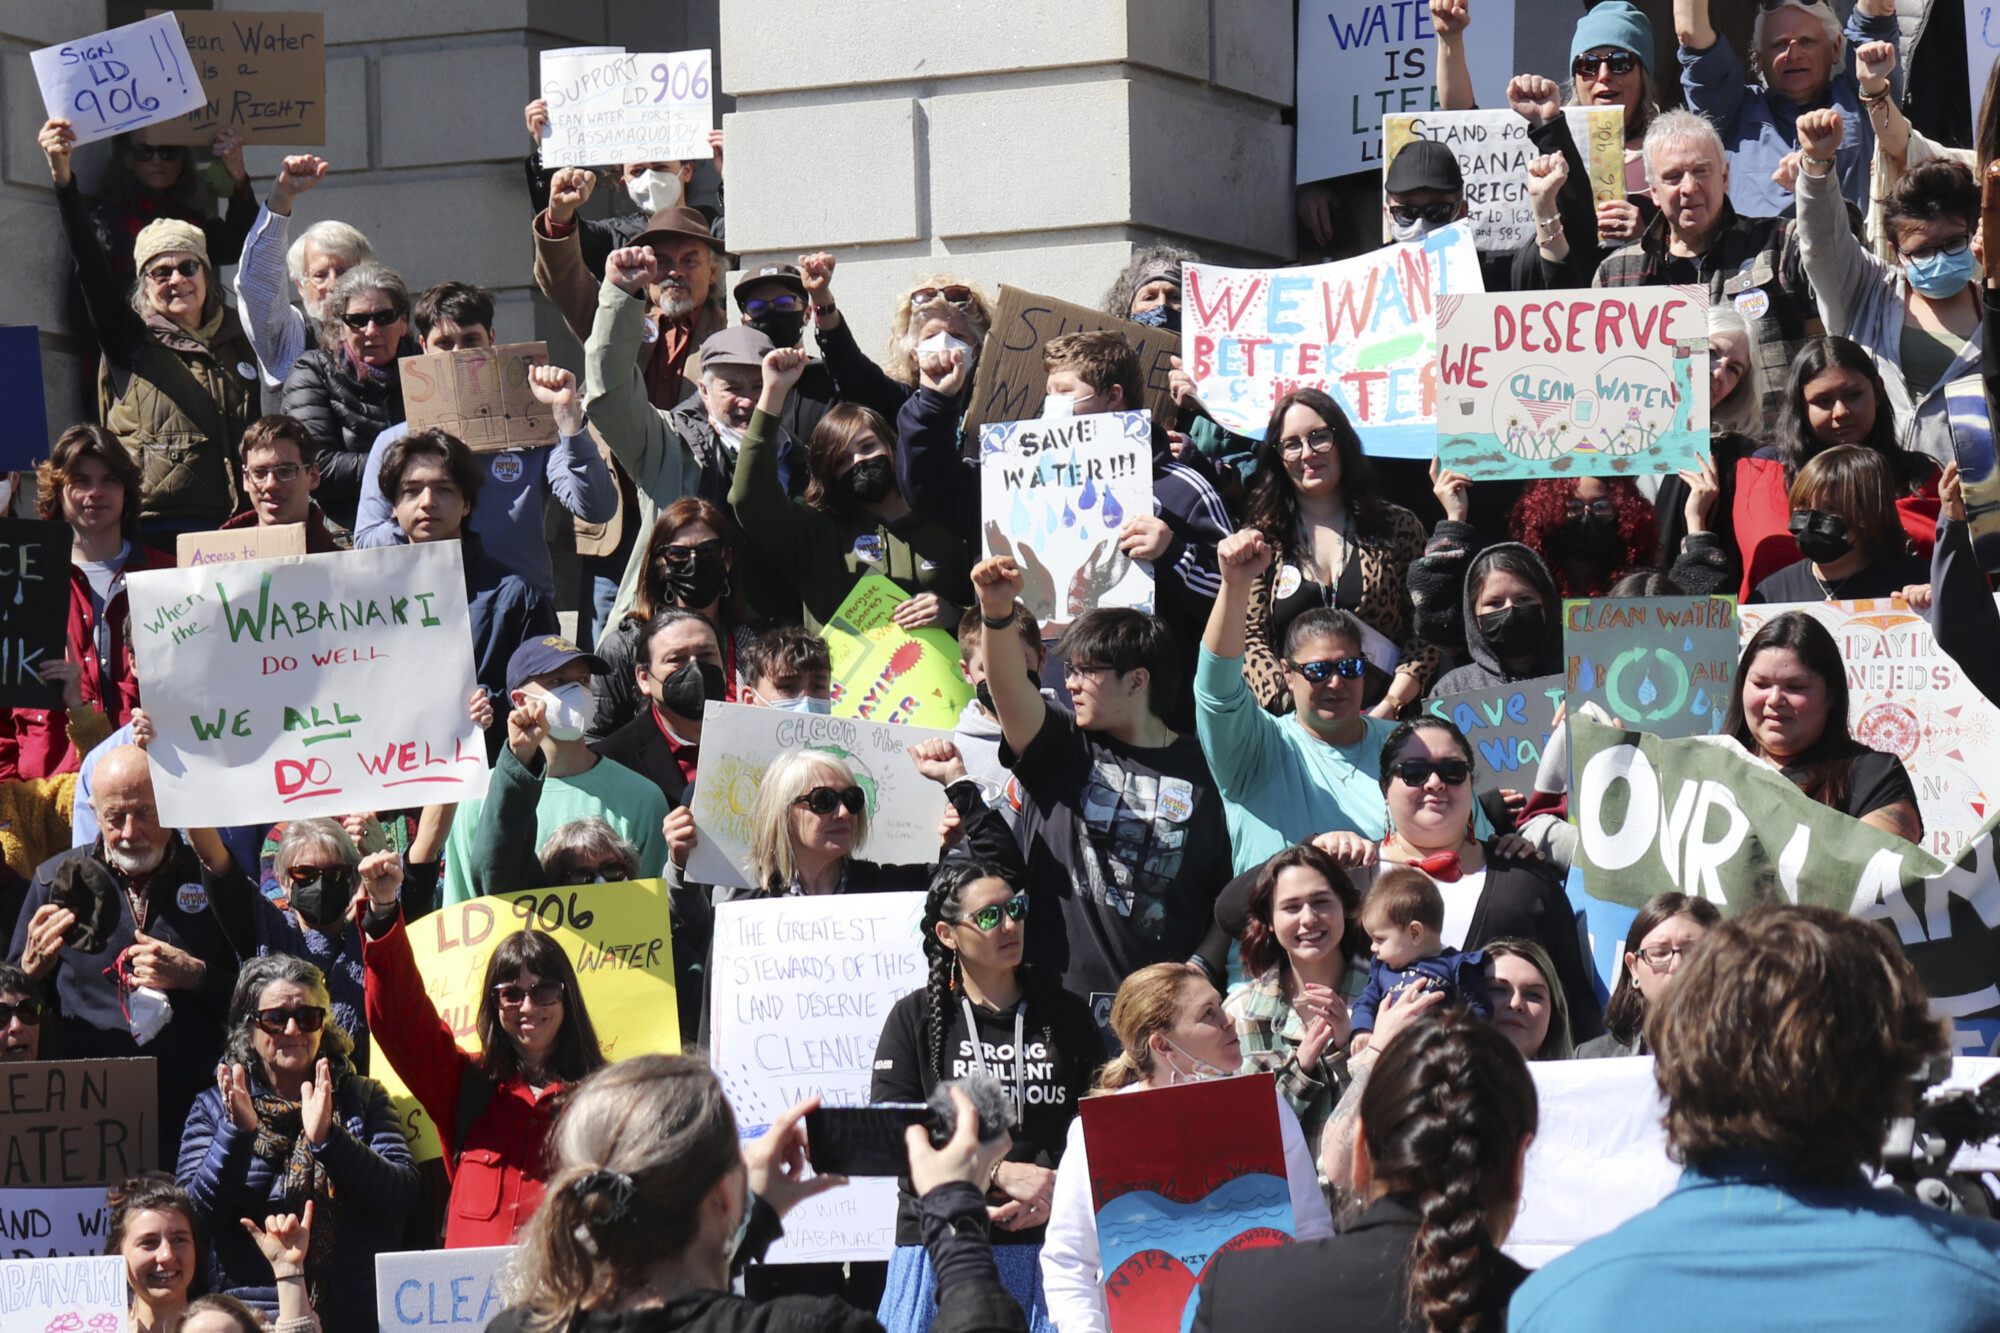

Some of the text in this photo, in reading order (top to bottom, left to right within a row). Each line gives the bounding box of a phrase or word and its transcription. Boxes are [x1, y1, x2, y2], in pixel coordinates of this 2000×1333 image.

[181, 21, 315, 54] lean Water
[1328, 0, 1437, 50] WATE
[59, 40, 114, 66] SIGN
[203, 60, 258, 79] is a
[1384, 48, 1426, 81] IS
[89, 60, 130, 86] LD
[543, 53, 640, 109] SUPPORT
[622, 60, 709, 105] LD 906
[74, 77, 160, 123] 906
[230, 90, 315, 126] RIGHT
[550, 113, 583, 126] LEAN
[588, 109, 625, 124] WATER
[1190, 227, 1461, 344] WE WANT
[1193, 335, 1349, 382] BETTER
[1441, 299, 1688, 388] WE DESERVE
[1273, 360, 1437, 422] ATE
[1510, 373, 1575, 402] CLEAN
[190, 545, 257, 567] Access to
[143, 594, 205, 636] When
[216, 571, 441, 643] WABANAKI
[1567, 600, 1734, 632] CLEAN WATER
[171, 618, 210, 645] the
[1836, 631, 1937, 660] IPAYIK
[261, 646, 390, 675] DO WELL
[1848, 665, 1952, 691] NEEDS
[190, 702, 362, 741] WE ALL
[274, 737, 481, 795] DO WELL
[1579, 743, 1751, 906] OUR
[435, 892, 595, 953] LD 906
[735, 911, 887, 947] THE GREATEST
[577, 938, 663, 975] WATER
[733, 951, 916, 986] STEWARDS OF THIS
[736, 992, 785, 1025] LAND
[796, 990, 878, 1021] DESERVE
[754, 1033, 880, 1072] CLEANE
[0, 1068, 108, 1115] EAN
[3, 1111, 148, 1187] ATER!
